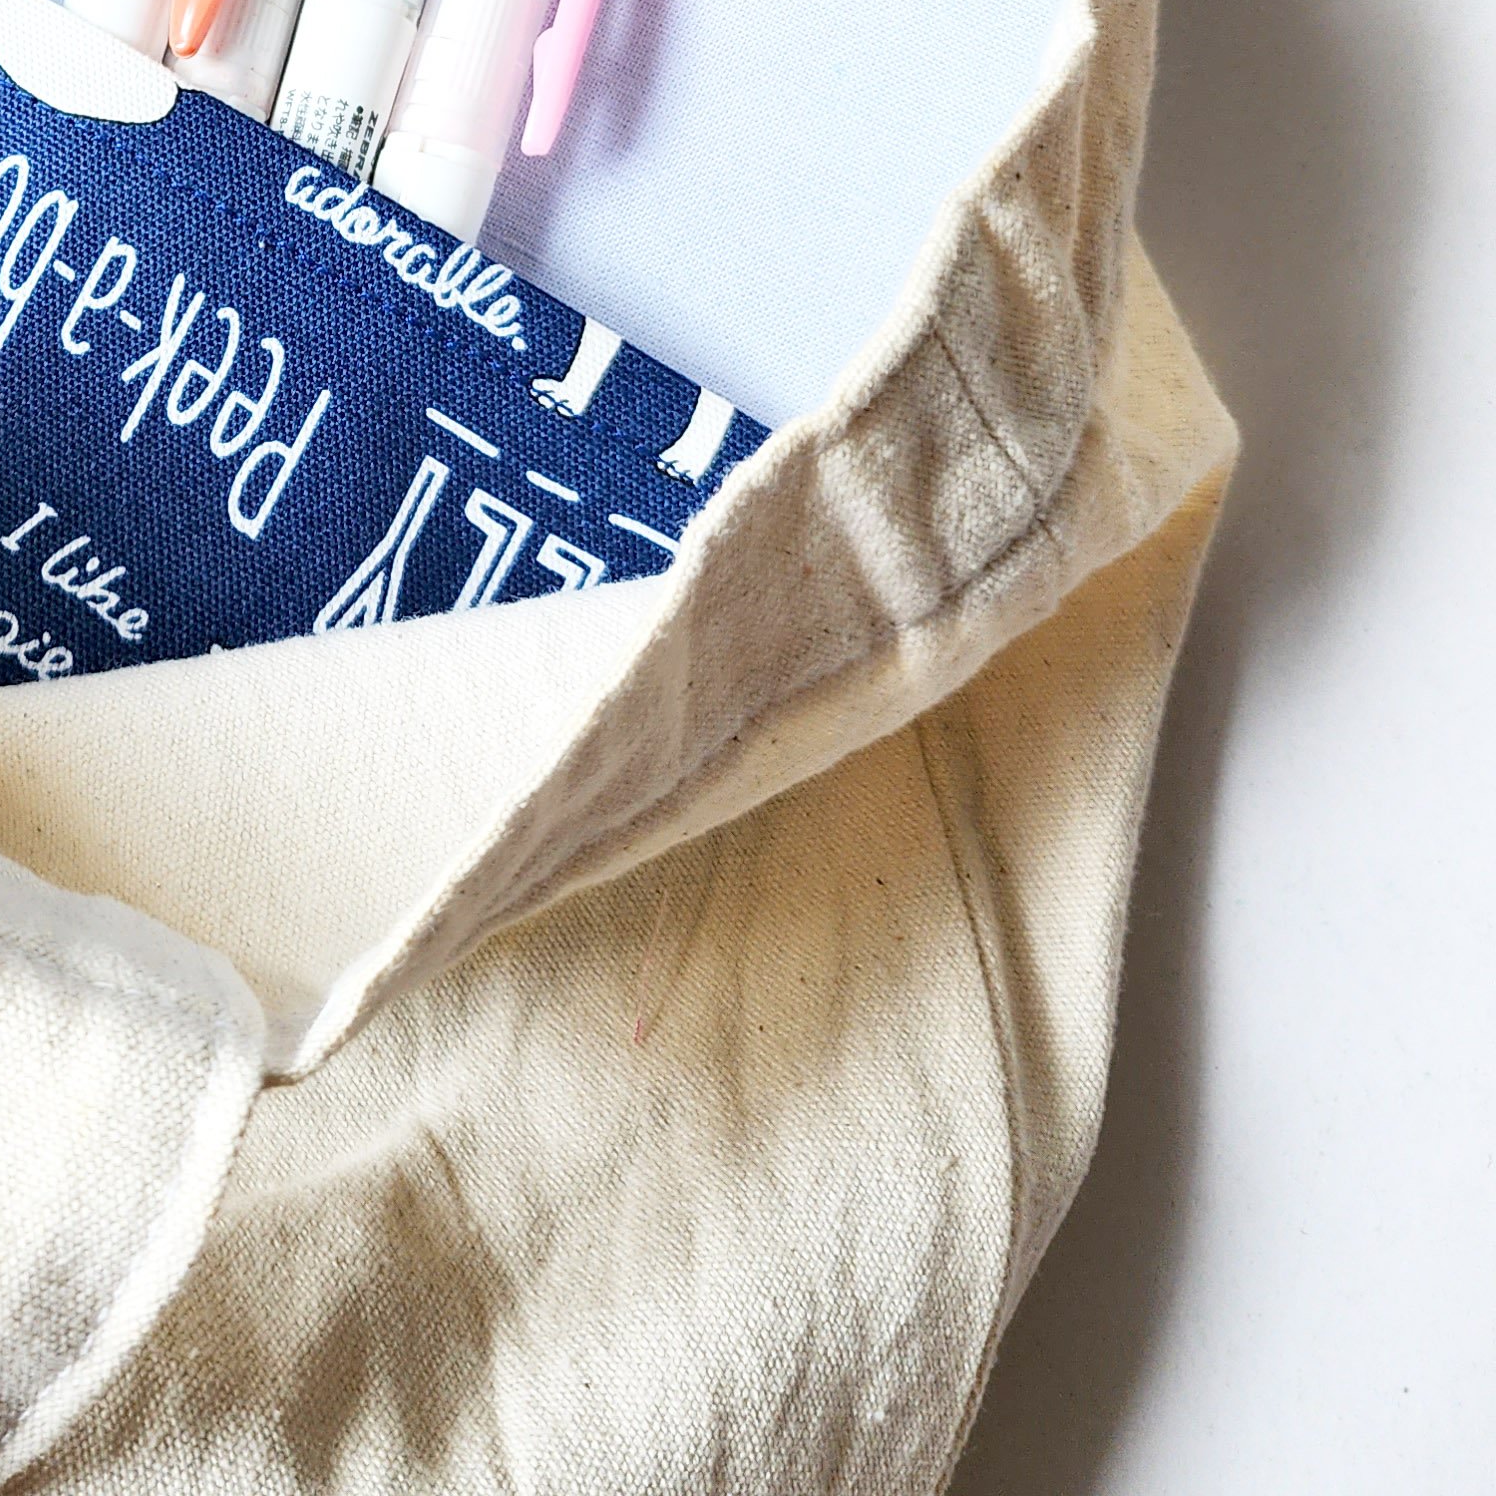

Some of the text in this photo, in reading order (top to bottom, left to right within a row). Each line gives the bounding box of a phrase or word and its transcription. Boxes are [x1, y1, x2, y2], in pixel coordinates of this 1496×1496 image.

[284, 165, 528, 351] adorable.
[0, 502, 150, 641] I like
